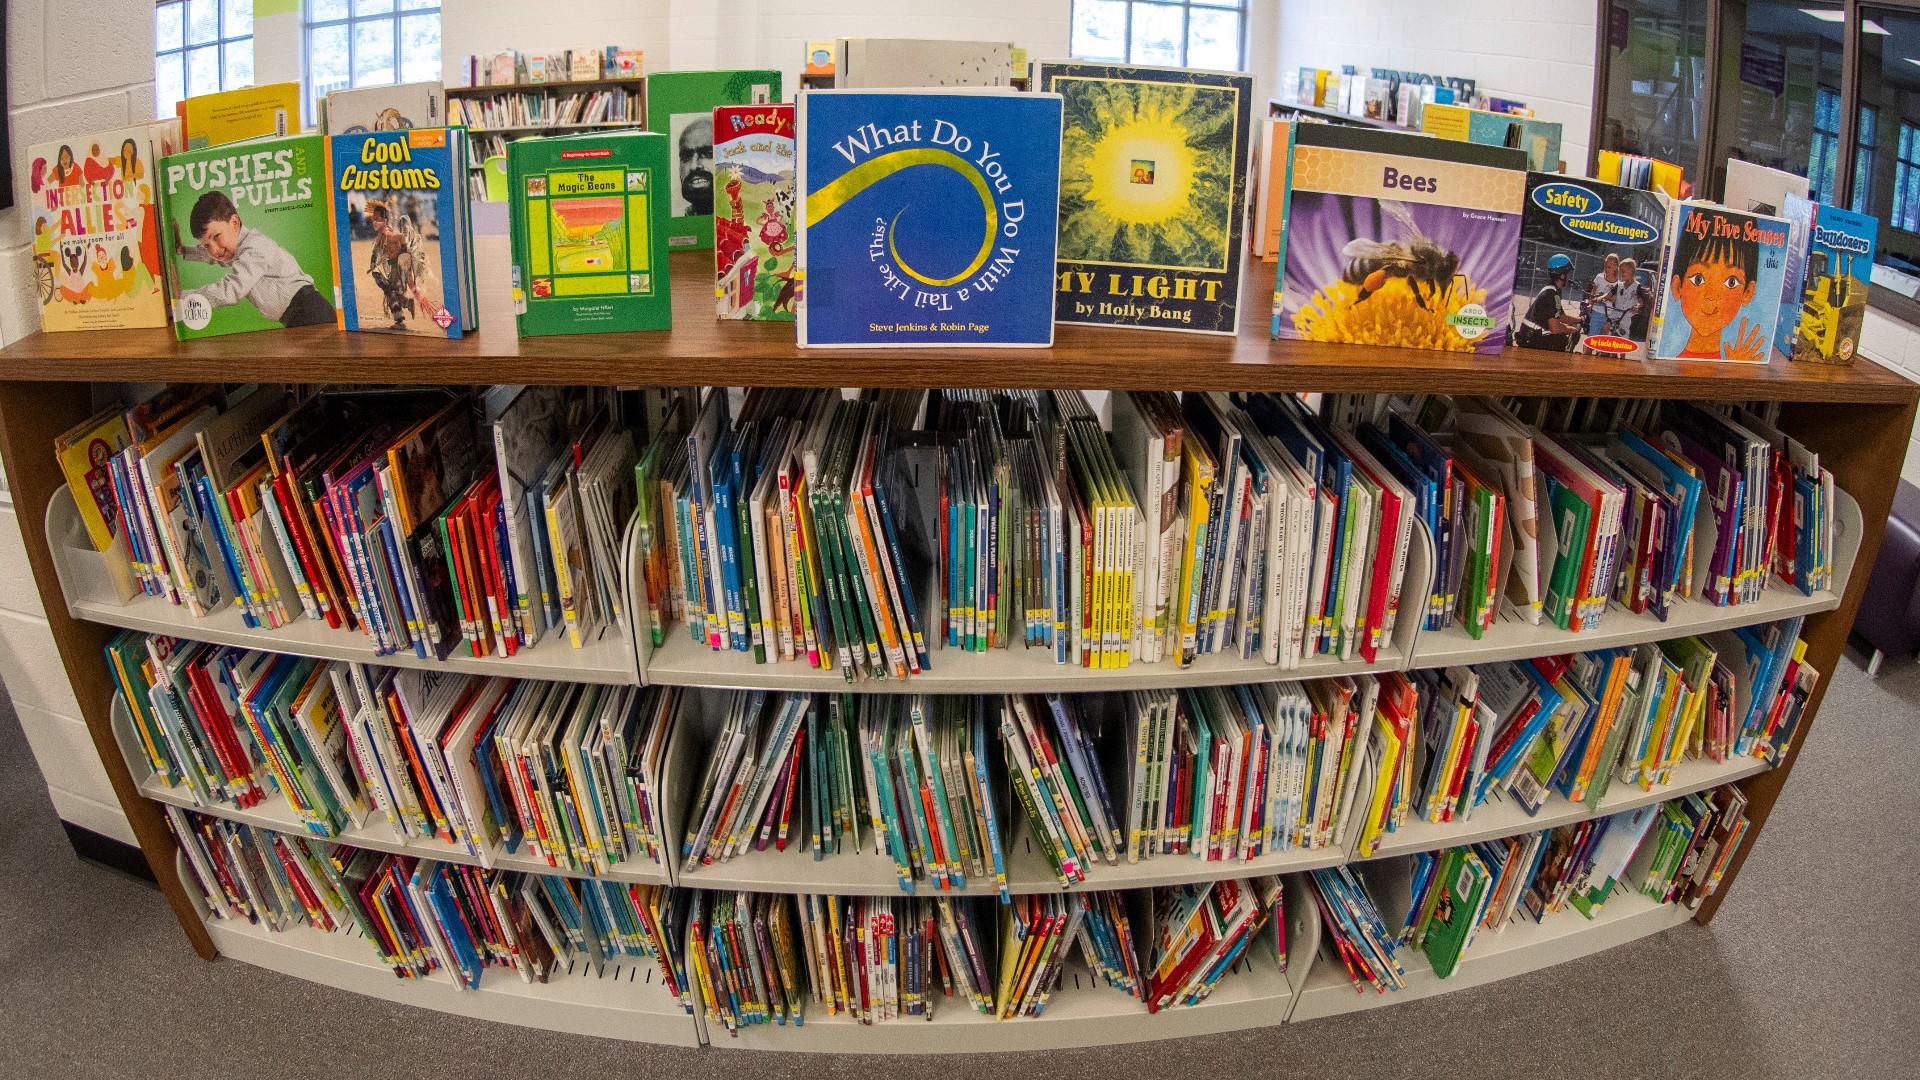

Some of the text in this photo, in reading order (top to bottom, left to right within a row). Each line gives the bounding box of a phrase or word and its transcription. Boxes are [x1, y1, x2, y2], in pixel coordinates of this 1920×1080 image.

[730, 109, 786, 133] Ready
[296, 147, 306, 175] AND
[361, 136, 411, 164] Cool
[167, 149, 293, 194] PUSHES
[341, 165, 440, 190] Customs
[578, 173, 595, 182] The
[1383, 167, 1437, 193] Bees
[46, 180, 134, 209] INTERSECTION
[230, 178, 312, 209] PULLS
[558, 182, 615, 193] Magic Beans
[1546, 189, 1590, 213] Safety
[61, 202, 127, 235] ALLIES
[832, 119, 1025, 311] What Do You Do With a Tail Like This?
[1569, 218, 1649, 239] around Strangers
[1685, 210, 1711, 240] My
[1712, 215, 1740, 239] Five
[1743, 220, 1785, 248] Senses
[1816, 227, 1869, 252] Bulldozers
[1056, 271, 1223, 302] MY LIGHT
[185, 308, 208, 320] SCIENCE
[1075, 302, 1191, 323] by Molly Bang
[1453, 316, 1490, 327] INSECTS
[870, 323, 989, 333] Steve Jenkins & Robin Page
[1462, 328, 1477, 336] Kids
[1404, 516, 1412, 541] ANIMALS
[1399, 550, 1407, 572] WINTER
[1189, 593, 1198, 624] ANIMALS
